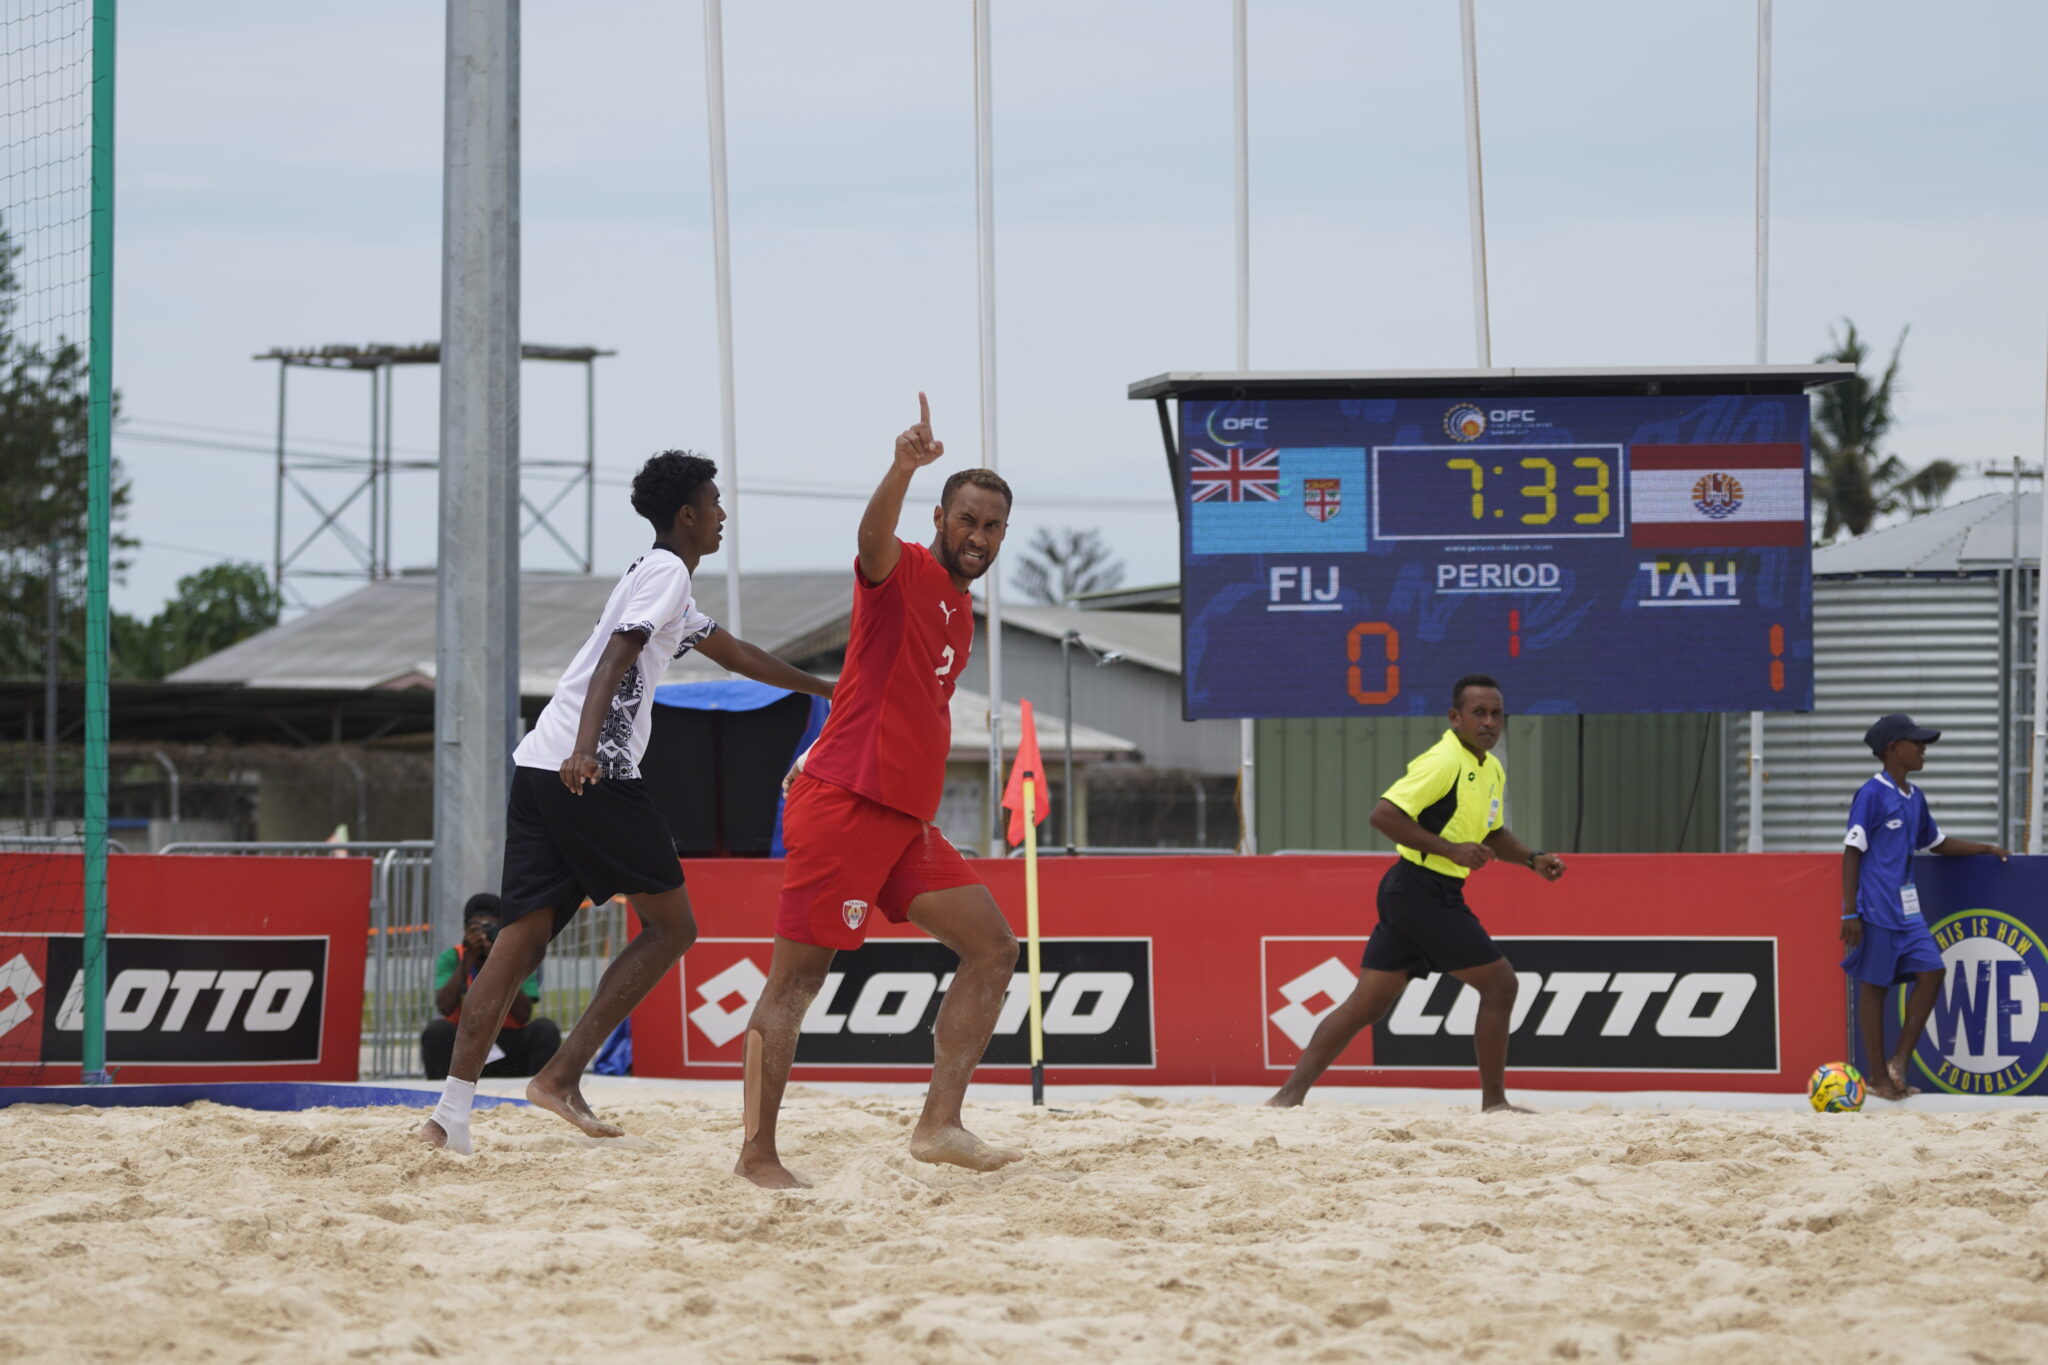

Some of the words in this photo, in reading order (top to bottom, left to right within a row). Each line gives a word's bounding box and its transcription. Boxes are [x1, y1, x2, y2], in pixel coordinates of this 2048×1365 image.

[1223, 417, 1269, 430] OFC
[1489, 410, 1536, 422] OFC
[1447, 457, 1610, 525] 7:33
[1270, 566, 1340, 601] FIJ
[1437, 563, 1560, 588] PERIOD
[1640, 561, 1737, 597] TAH
[1509, 608, 1520, 659] 1
[1347, 622, 1400, 705] 0
[1769, 623, 1784, 692] 1
[1934, 921, 1965, 951] HIS
[1972, 917, 1989, 937] IS
[1996, 922, 2033, 956] HOW
[800, 971, 1134, 1035] LOTO
[1932, 960, 2030, 1057] WE
[1938, 1061, 2028, 1093] FOOTBALL
